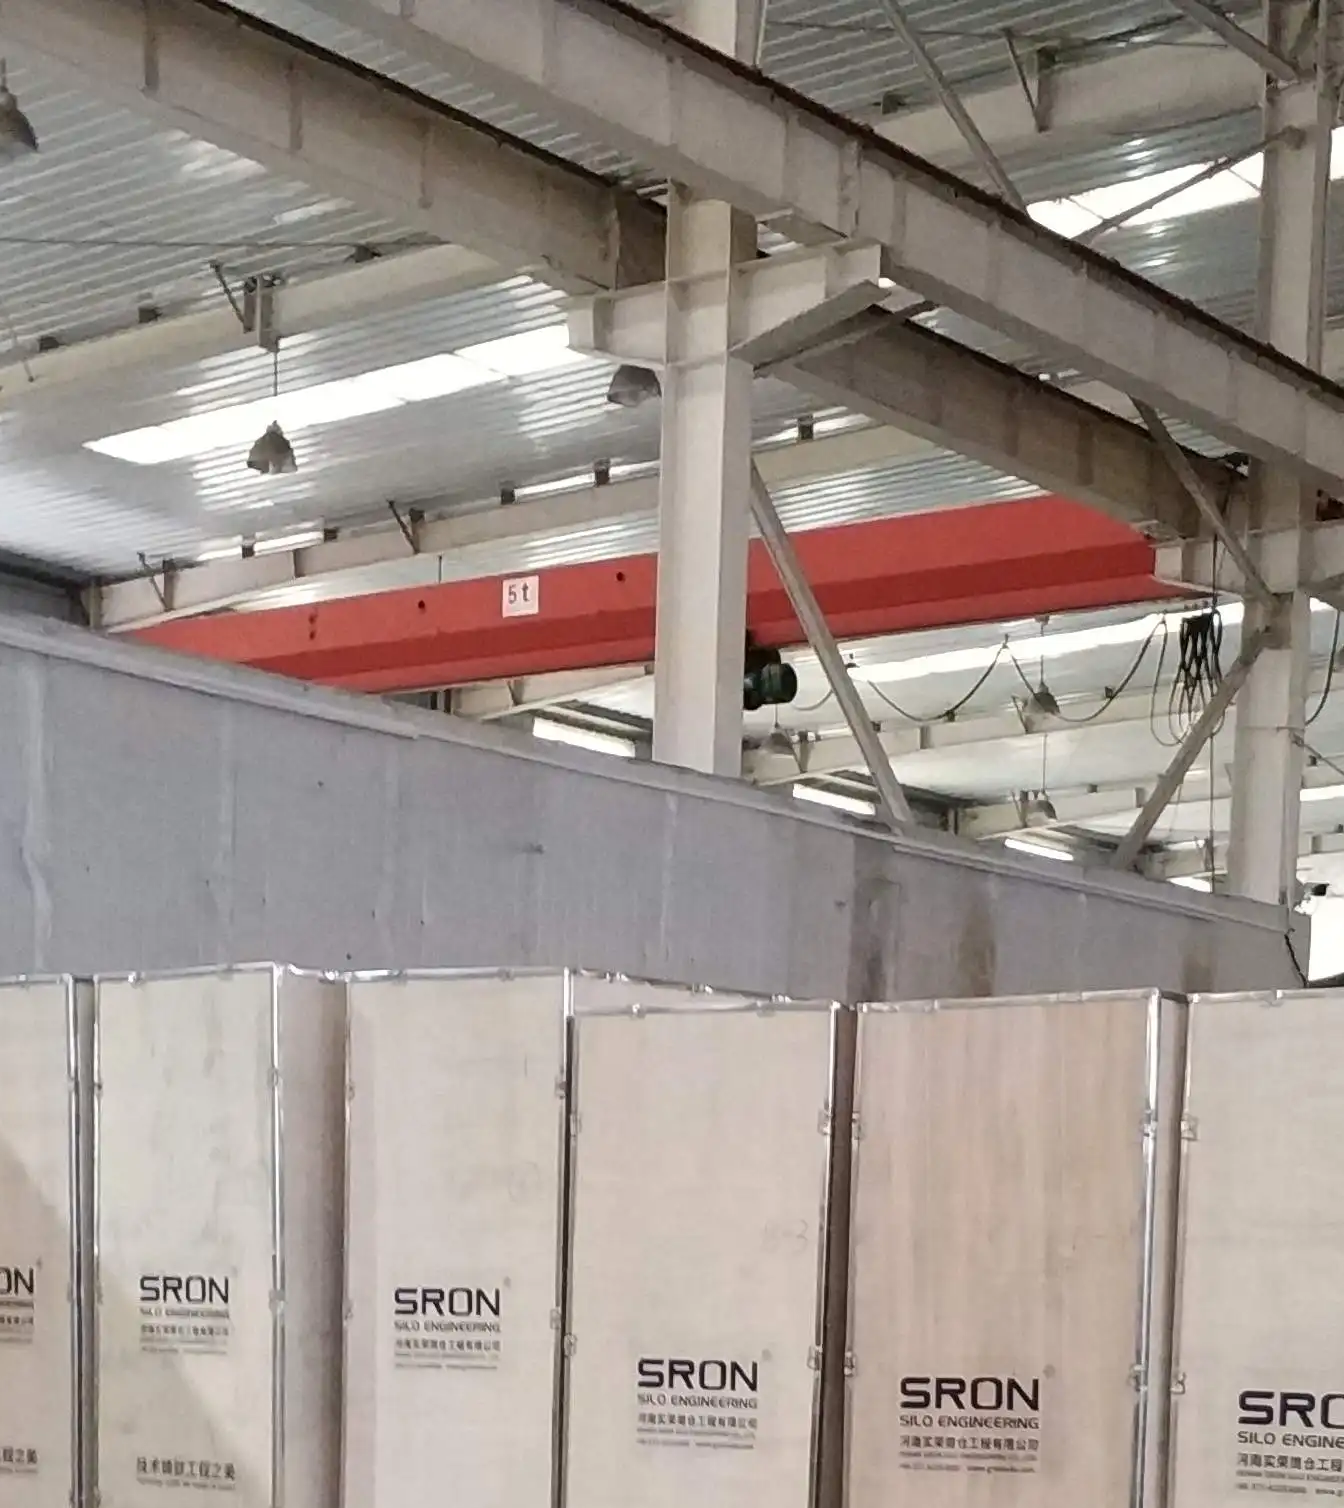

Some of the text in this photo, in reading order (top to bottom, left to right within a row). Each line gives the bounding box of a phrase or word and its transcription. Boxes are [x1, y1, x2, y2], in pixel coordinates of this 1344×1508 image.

[140, 1275, 229, 1304] SRON
[394, 1287, 500, 1317] SRON
[637, 1357, 758, 1392] SRON
[900, 1376, 1039, 1411] SRON
[900, 1415, 1039, 1430] SILO ENGINEERING
[1237, 1431, 1276, 1445] SILO
